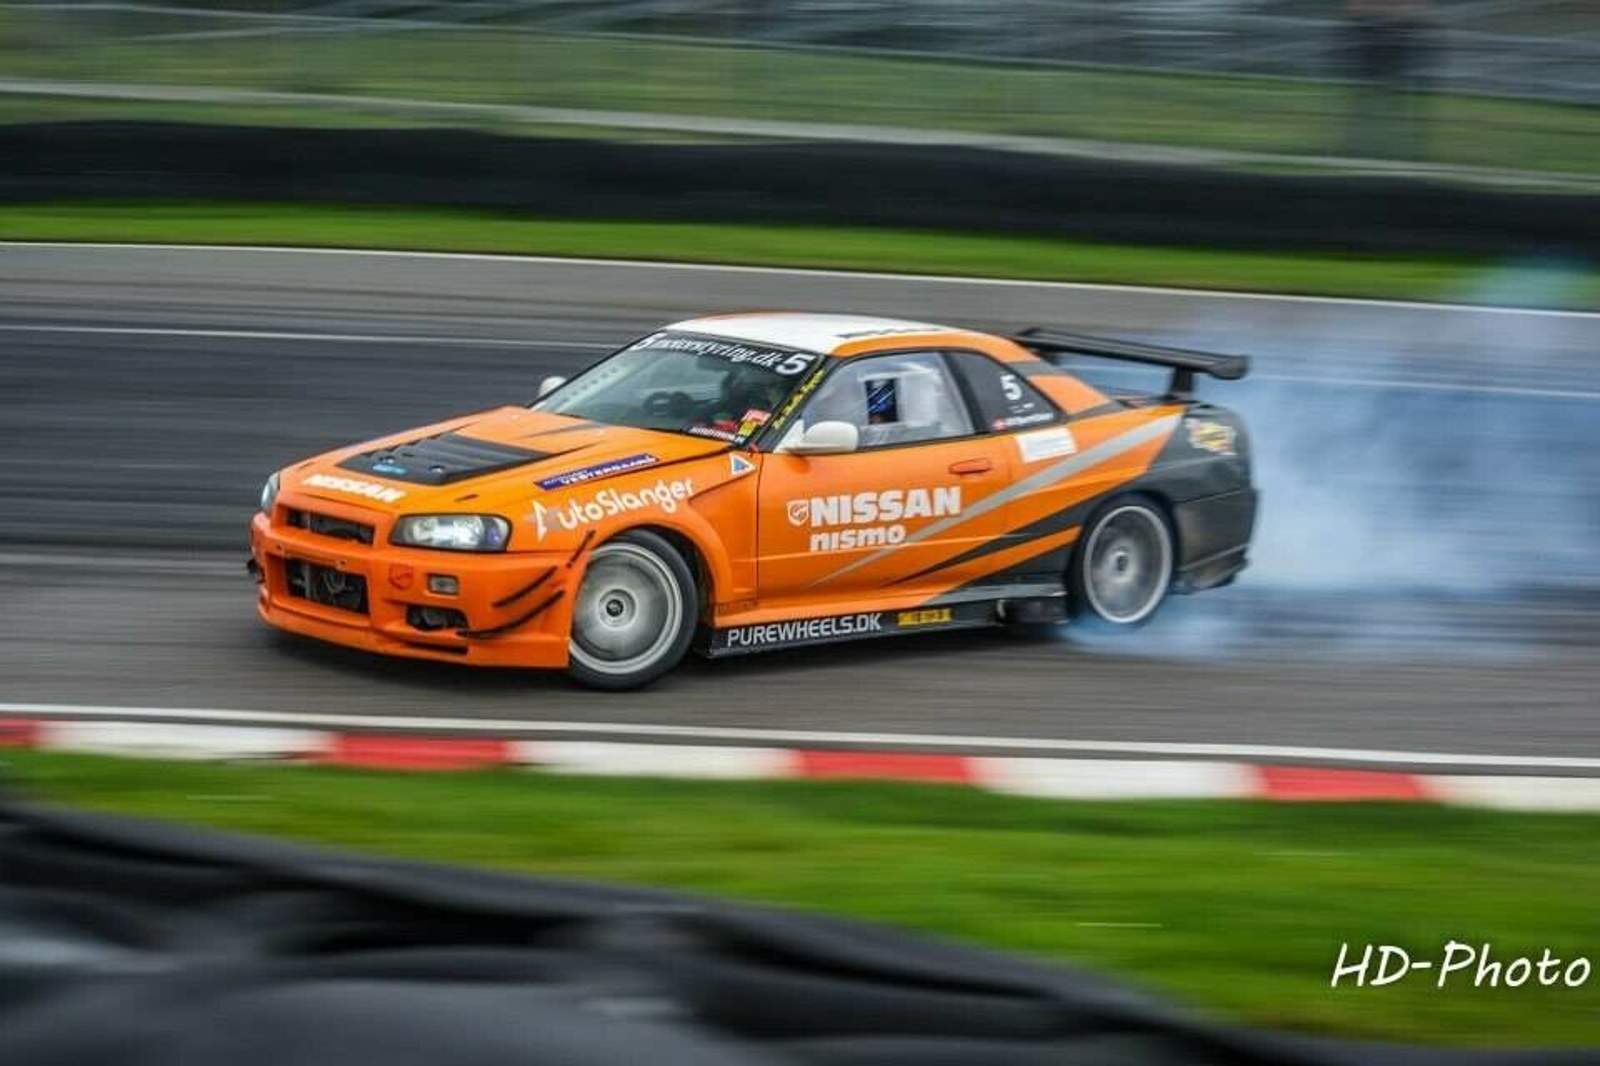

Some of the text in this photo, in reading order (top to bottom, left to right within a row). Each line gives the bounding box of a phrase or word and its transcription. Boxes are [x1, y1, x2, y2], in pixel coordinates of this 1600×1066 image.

[775, 353, 817, 376] 5
[1000, 374, 1022, 400] 5
[810, 486, 961, 527] NISSAN
[809, 524, 907, 552] nismo
[726, 612, 882, 646] PUREWHEELS.DK
